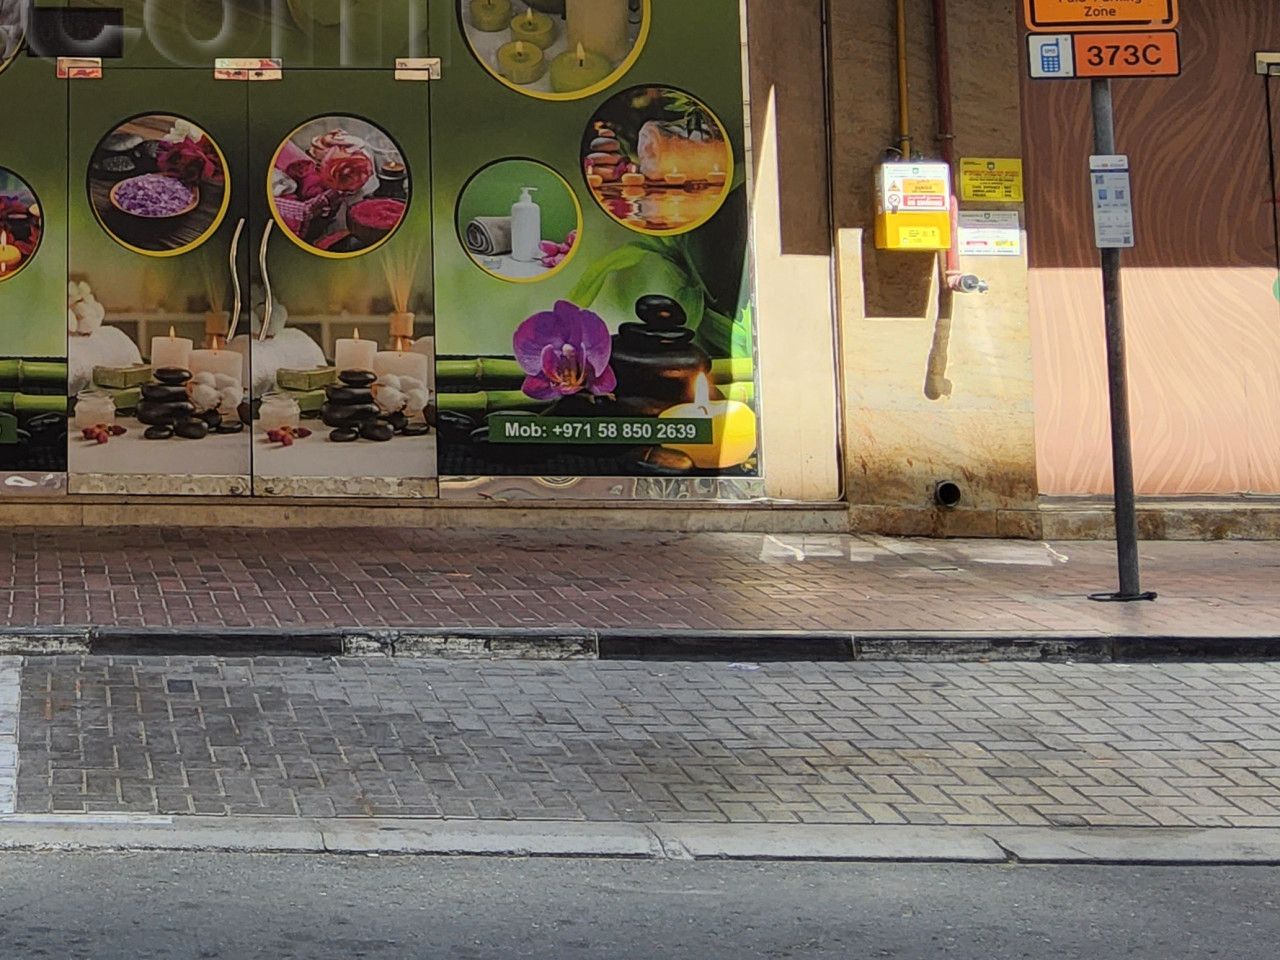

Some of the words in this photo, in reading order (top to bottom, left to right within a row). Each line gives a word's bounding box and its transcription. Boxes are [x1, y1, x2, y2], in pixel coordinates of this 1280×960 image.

[1084, 6, 1117, 17] Zone
[1086, 42, 1163, 69] 373C
[505, 422, 547, 437] Mob:
[552, 423, 591, 438] +971
[598, 423, 617, 438] 58
[622, 423, 651, 438] 850
[656, 423, 696, 439] 2639
